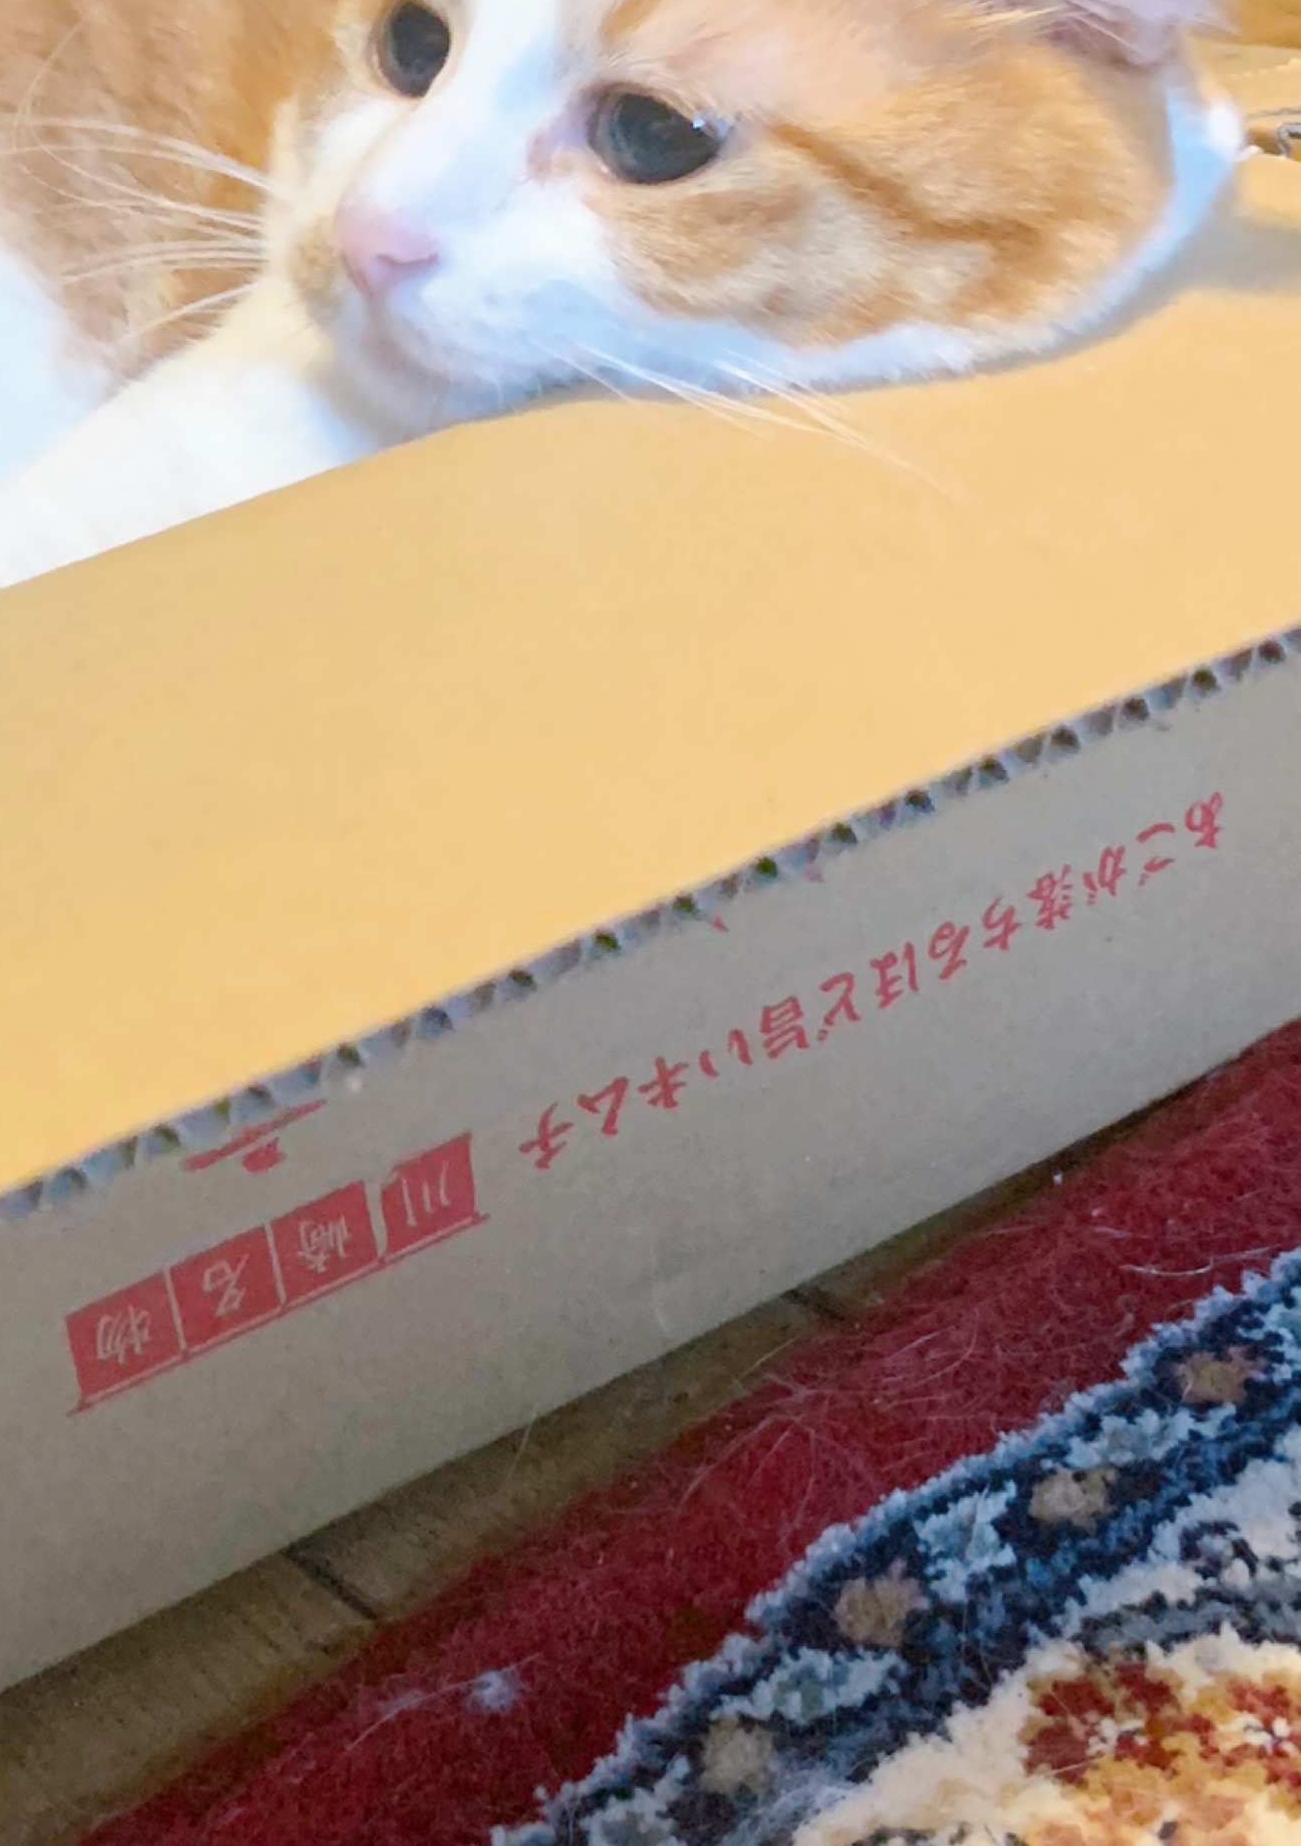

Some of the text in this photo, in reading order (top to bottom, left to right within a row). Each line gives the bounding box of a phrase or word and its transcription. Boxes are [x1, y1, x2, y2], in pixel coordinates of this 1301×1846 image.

[519, 792, 1224, 1170] あごが落ちるほど旨いキムチ
[95, 1160, 452, 1365] 川崎名物
